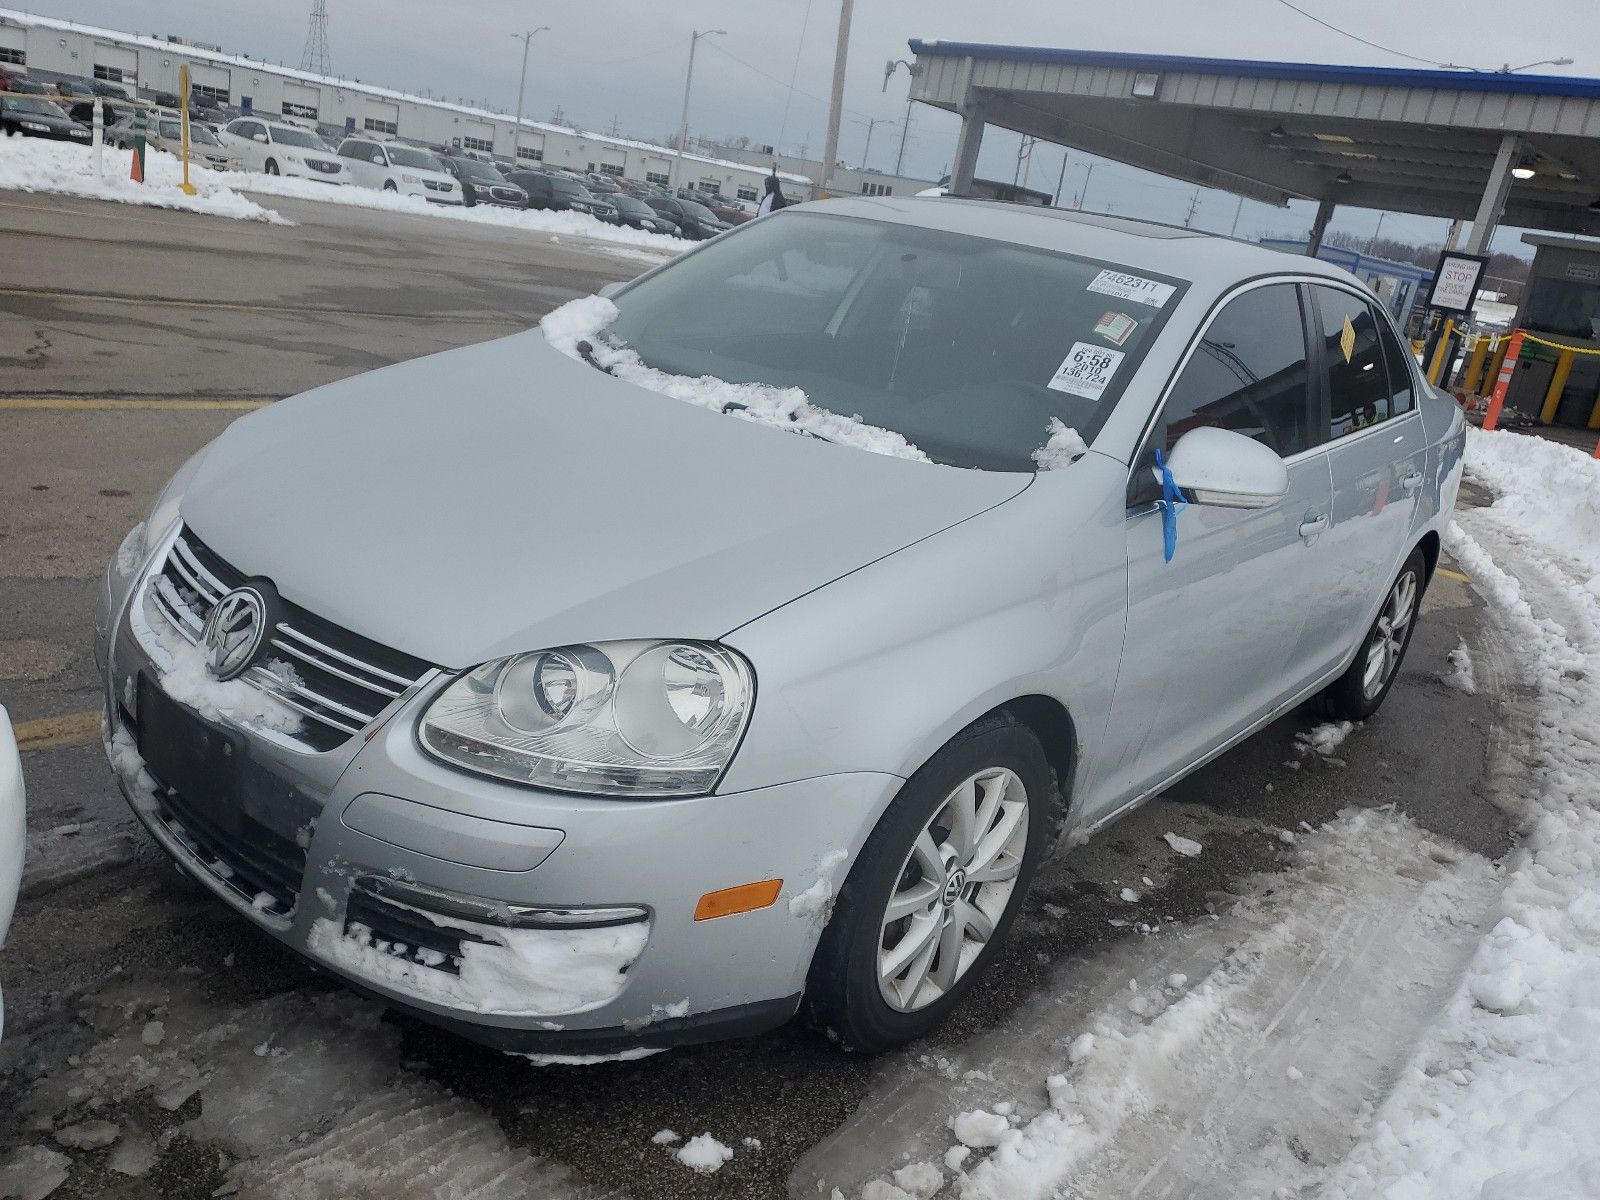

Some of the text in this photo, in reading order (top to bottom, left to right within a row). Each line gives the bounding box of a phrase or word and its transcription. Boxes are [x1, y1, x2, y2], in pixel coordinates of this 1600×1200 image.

[1101, 271, 1158, 292] 7462311
[1445, 270, 1472, 282] STOP
[1062, 367, 1107, 384] 136,724
[1074, 362, 1102, 375] 2010
[204, 587, 266, 682] VW
